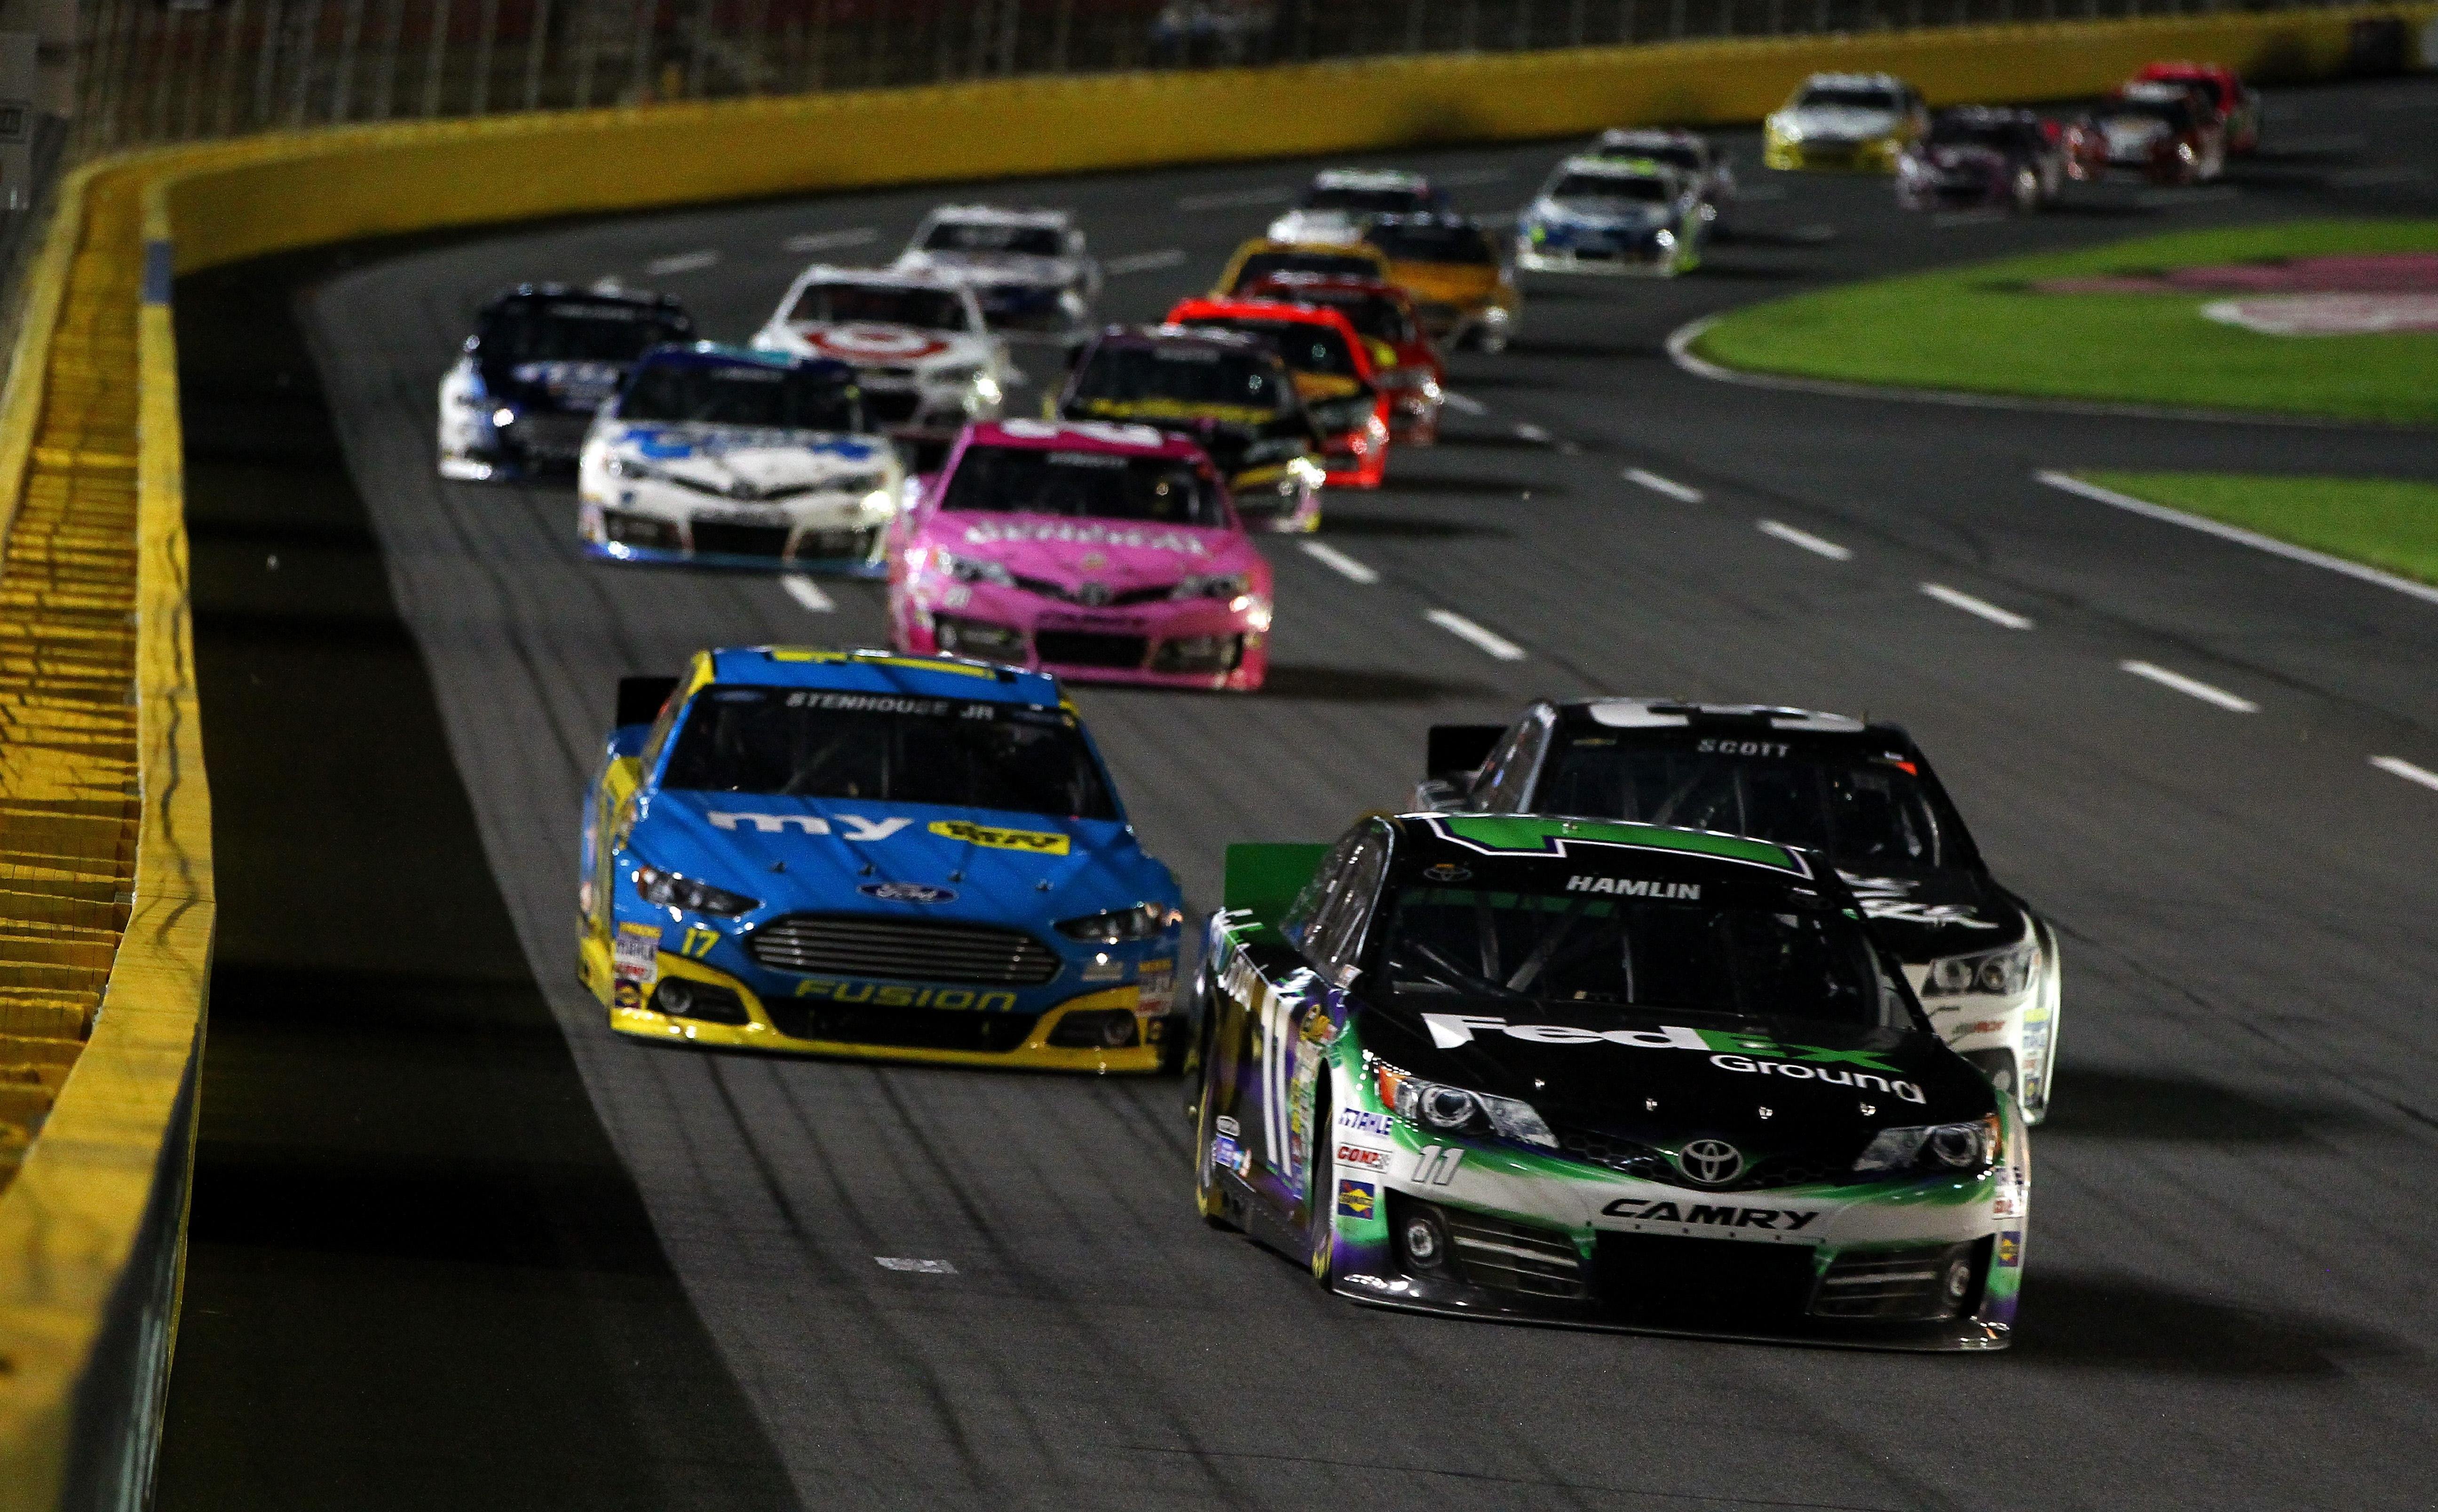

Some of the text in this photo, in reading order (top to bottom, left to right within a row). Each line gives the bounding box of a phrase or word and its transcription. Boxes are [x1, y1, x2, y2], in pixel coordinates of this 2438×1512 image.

[1697, 738, 1790, 757] SCOTT
[707, 811, 913, 841] my
[1565, 875, 1701, 900] HAMLIN
[681, 927, 720, 958] 17
[795, 979, 1017, 1012] FUSION
[1421, 1013, 1905, 1072] FedEx
[1709, 1054, 1927, 1105] Ground
[1411, 1144, 1465, 1186] 11
[1601, 1197, 1820, 1230] CAMRY
